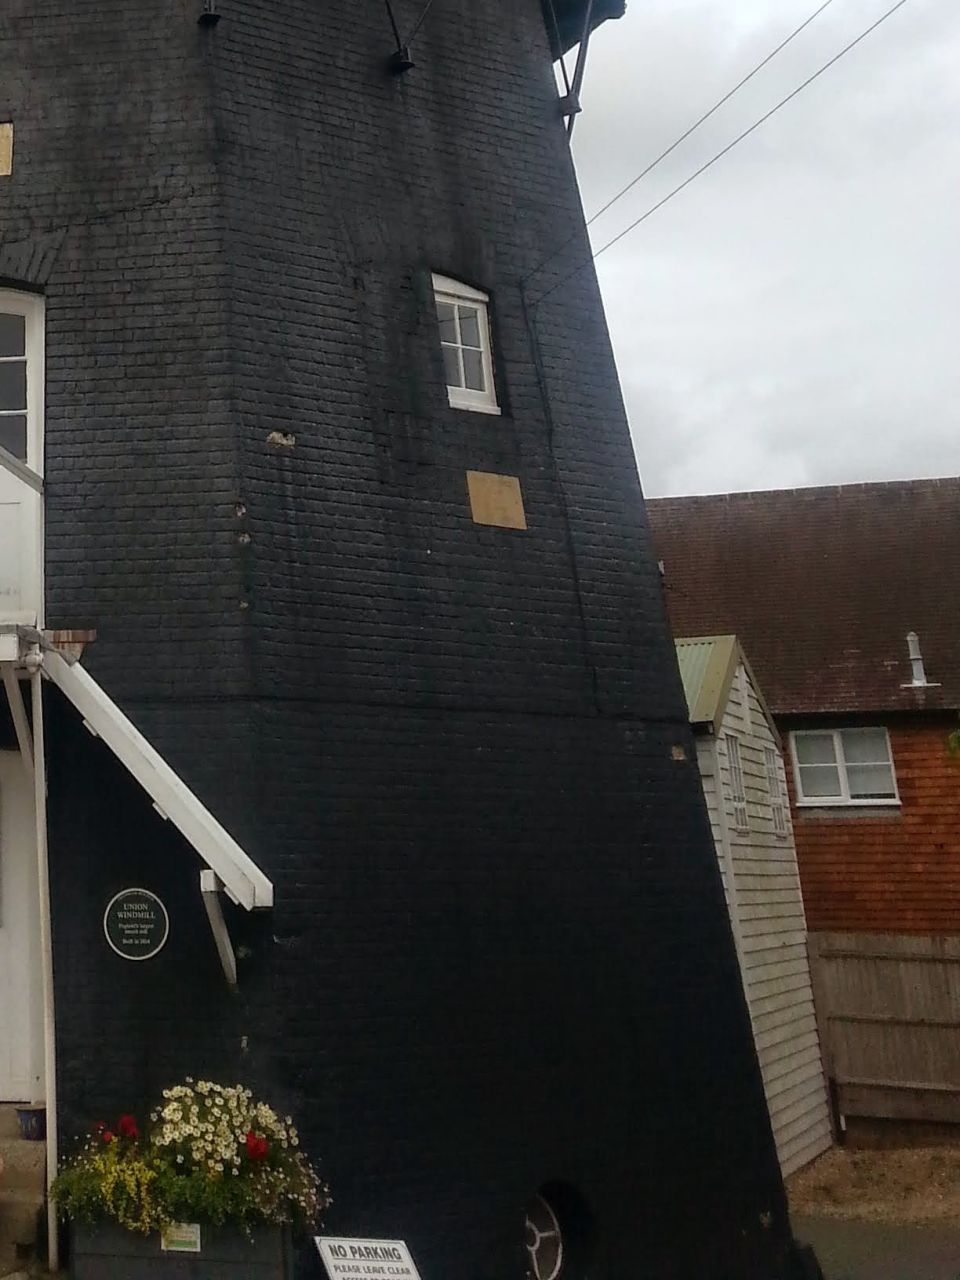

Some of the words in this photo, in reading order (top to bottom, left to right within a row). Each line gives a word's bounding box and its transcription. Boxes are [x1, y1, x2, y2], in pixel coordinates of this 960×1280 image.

[117, 911, 156, 919] WINDMILL
[328, 1244, 347, 1258] NO
[349, 1245, 402, 1260] PARKING
[333, 1264, 362, 1273] PLEASE
[362, 1265, 387, 1274] LEAVE
[387, 1266, 411, 1275] CLEAR
